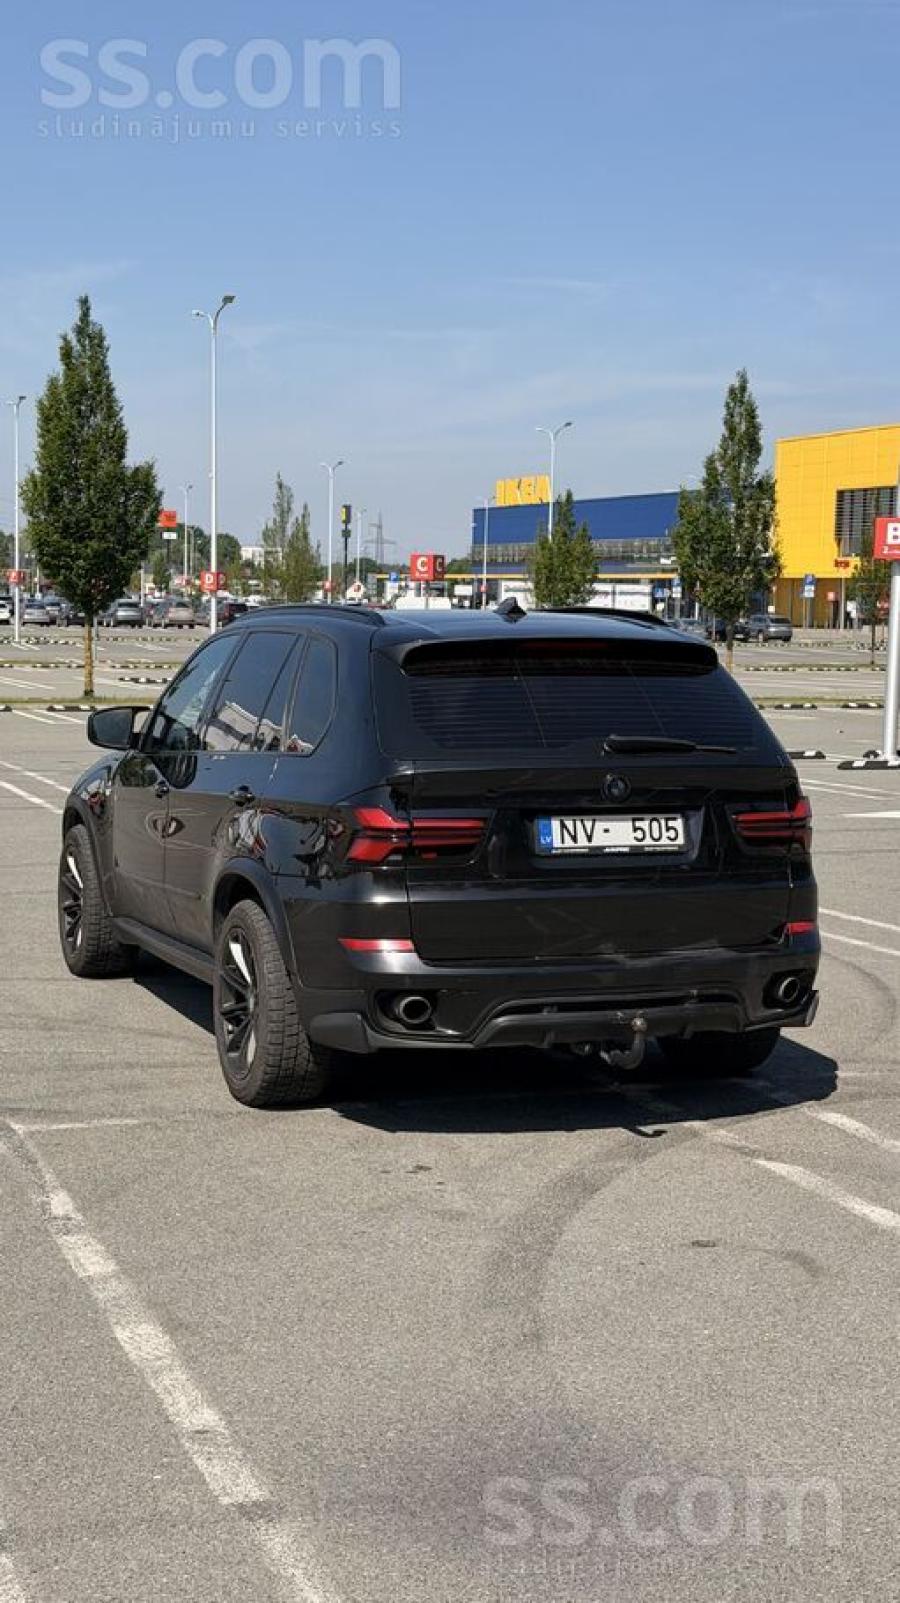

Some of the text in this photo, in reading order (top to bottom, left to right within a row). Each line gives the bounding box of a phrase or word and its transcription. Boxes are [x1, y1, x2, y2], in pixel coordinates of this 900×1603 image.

[496, 475, 551, 507] IKEA
[416, 556, 428, 571] C
[632, 817, 679, 842] 505
